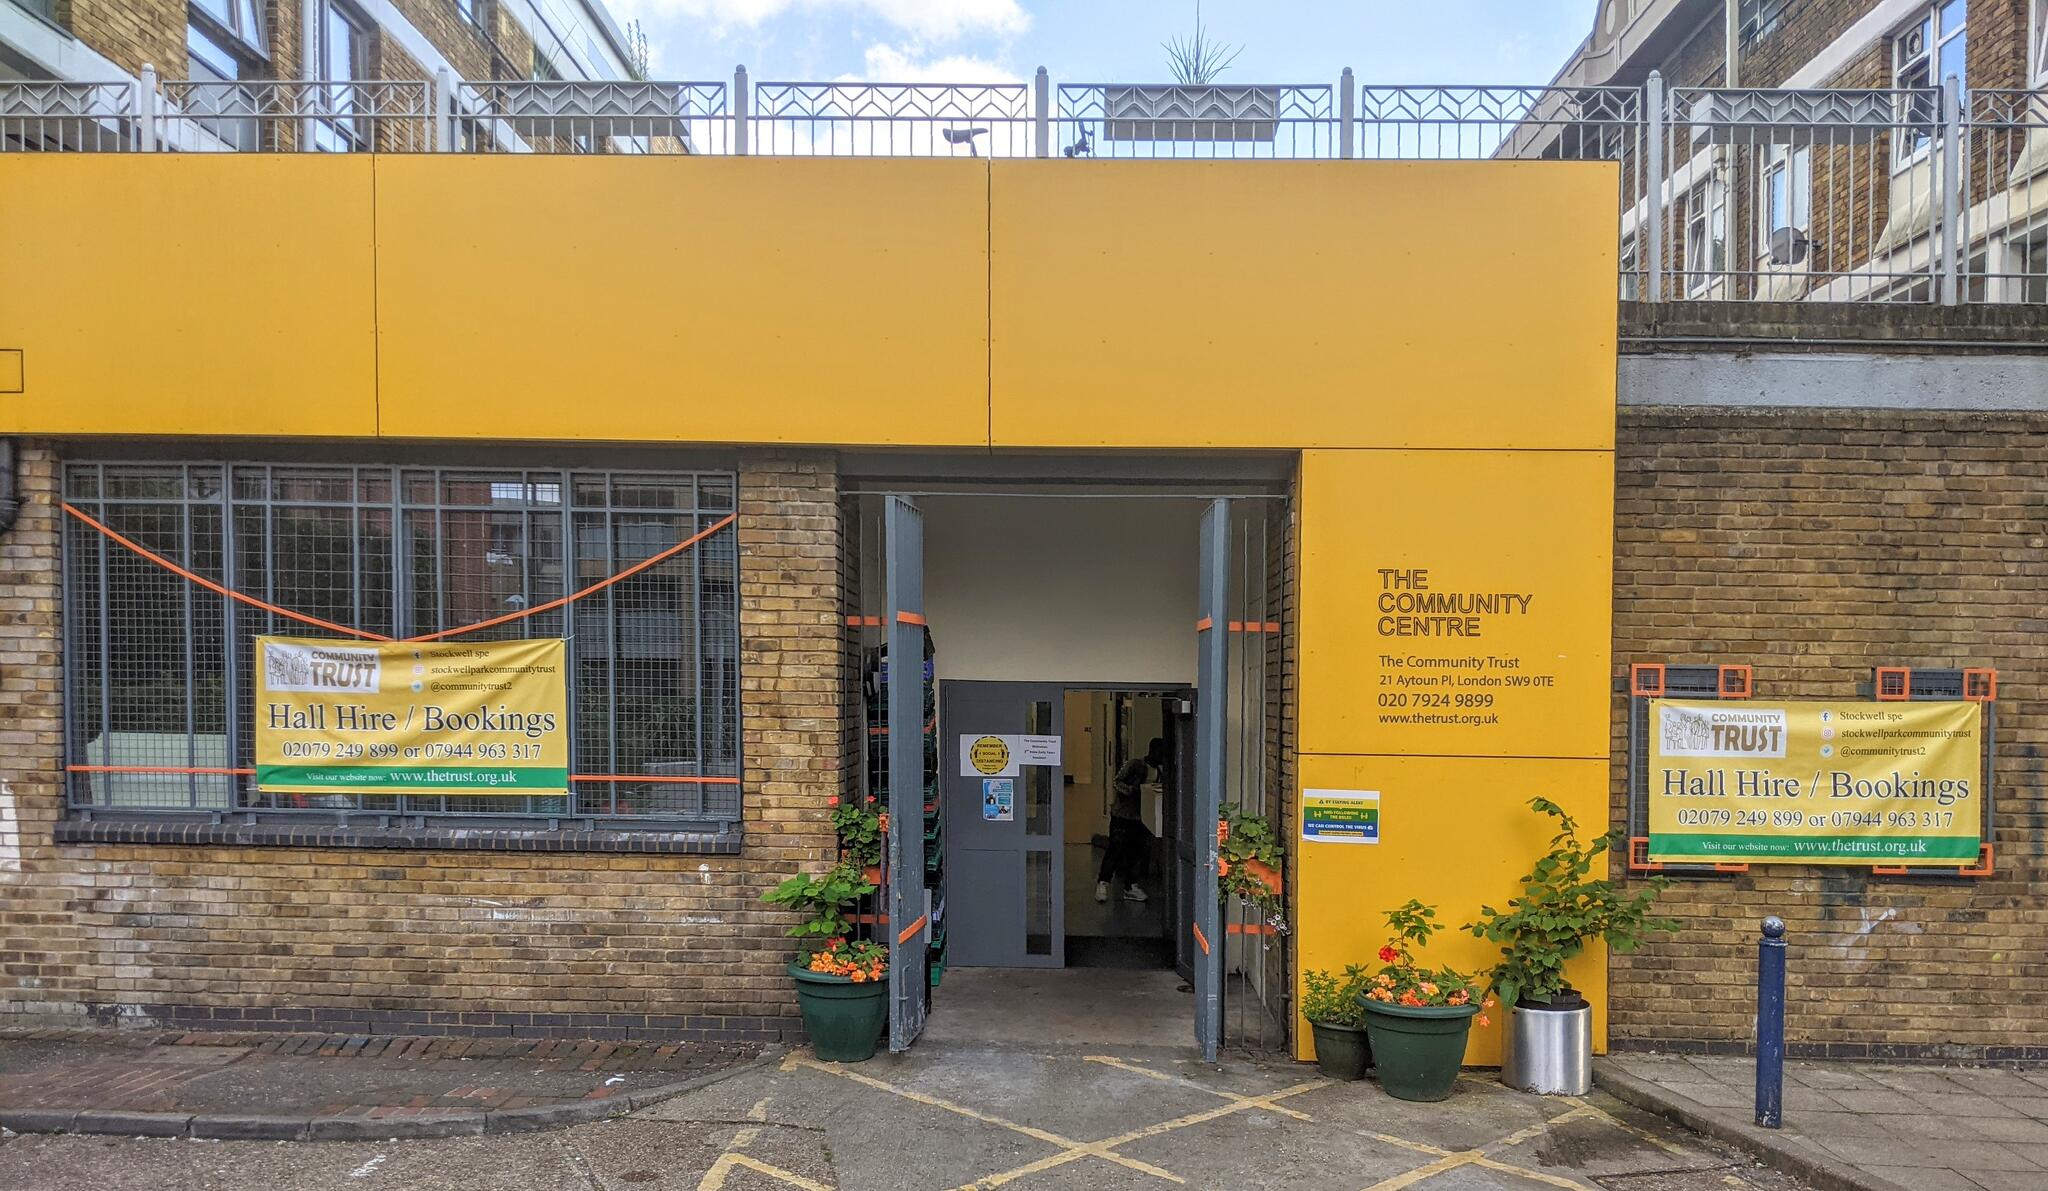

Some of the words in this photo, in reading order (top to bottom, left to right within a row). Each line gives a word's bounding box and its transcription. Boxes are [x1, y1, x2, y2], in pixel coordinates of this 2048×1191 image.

[1378, 569, 1428, 589] THE
[1378, 592, 1533, 614] COMMUNITY
[1378, 616, 1481, 636] CENTRE
[311, 650, 376, 662] COMMUNITY
[430, 649, 473, 658] Stockwell
[431, 664, 555, 676] stockwellparkcommunitytrust
[1379, 655, 1403, 668] The
[1407, 655, 1484, 671] Community
[1487, 656, 1519, 668] Trust
[310, 661, 376, 687] TRUST
[1379, 675, 1392, 685] 21
[1396, 675, 1438, 688] Aytoun
[1441, 675, 1455, 688] Pl,
[1457, 675, 1501, 686] London
[1505, 676, 1530, 686] SW9
[1533, 676, 1554, 687] 0TE
[431, 681, 512, 693] @communitytrust2
[1378, 693, 1407, 707] 020
[1412, 693, 1450, 707] 7924
[1455, 693, 1494, 707] 9899
[268, 703, 324, 730] Hall
[335, 704, 397, 731] Hire
[403, 705, 414, 732] /
[423, 704, 556, 737] Bookings
[1379, 713, 1499, 726] www.thetrust.org.uk
[1712, 713, 1781, 724] COMMUNITY
[1840, 711, 1885, 721] Stockwell
[1711, 724, 1782, 752] TRUST
[1841, 728, 1971, 740] stockwellparkcommunitytrust
[282, 741, 331, 758] 02079
[335, 742, 364, 759] 249
[369, 742, 398, 759] 899
[404, 746, 421, 759] or
[425, 743, 473, 759] 07944
[479, 743, 506, 760] 963
[512, 743, 541, 760] 317
[1840, 746, 1926, 758] @communitytrust2
[306, 772, 323, 782] Visit
[324, 774, 338, 782] our
[339, 772, 369, 782] website
[369, 774, 387, 782] now:
[390, 770, 517, 785] www.thetrust.org.uk
[1662, 769, 1724, 797] Hall
[1736, 770, 1800, 798] Hire
[1809, 770, 1821, 798] /
[1830, 771, 1969, 805] Bookings
[1678, 809, 1731, 826] 02079
[1736, 810, 1767, 827] 249
[1773, 810, 1803, 827] 899
[1808, 814, 1826, 827] or
[1831, 811, 1882, 828] 07944
[1887, 811, 1916, 828] 963
[1922, 812, 1953, 828] 317
[1702, 841, 1720, 851] Visit
[1737, 841, 1769, 852] website
[1769, 844, 1790, 852] now:
[1793, 839, 1927, 855] www.thetrust.org.uk
